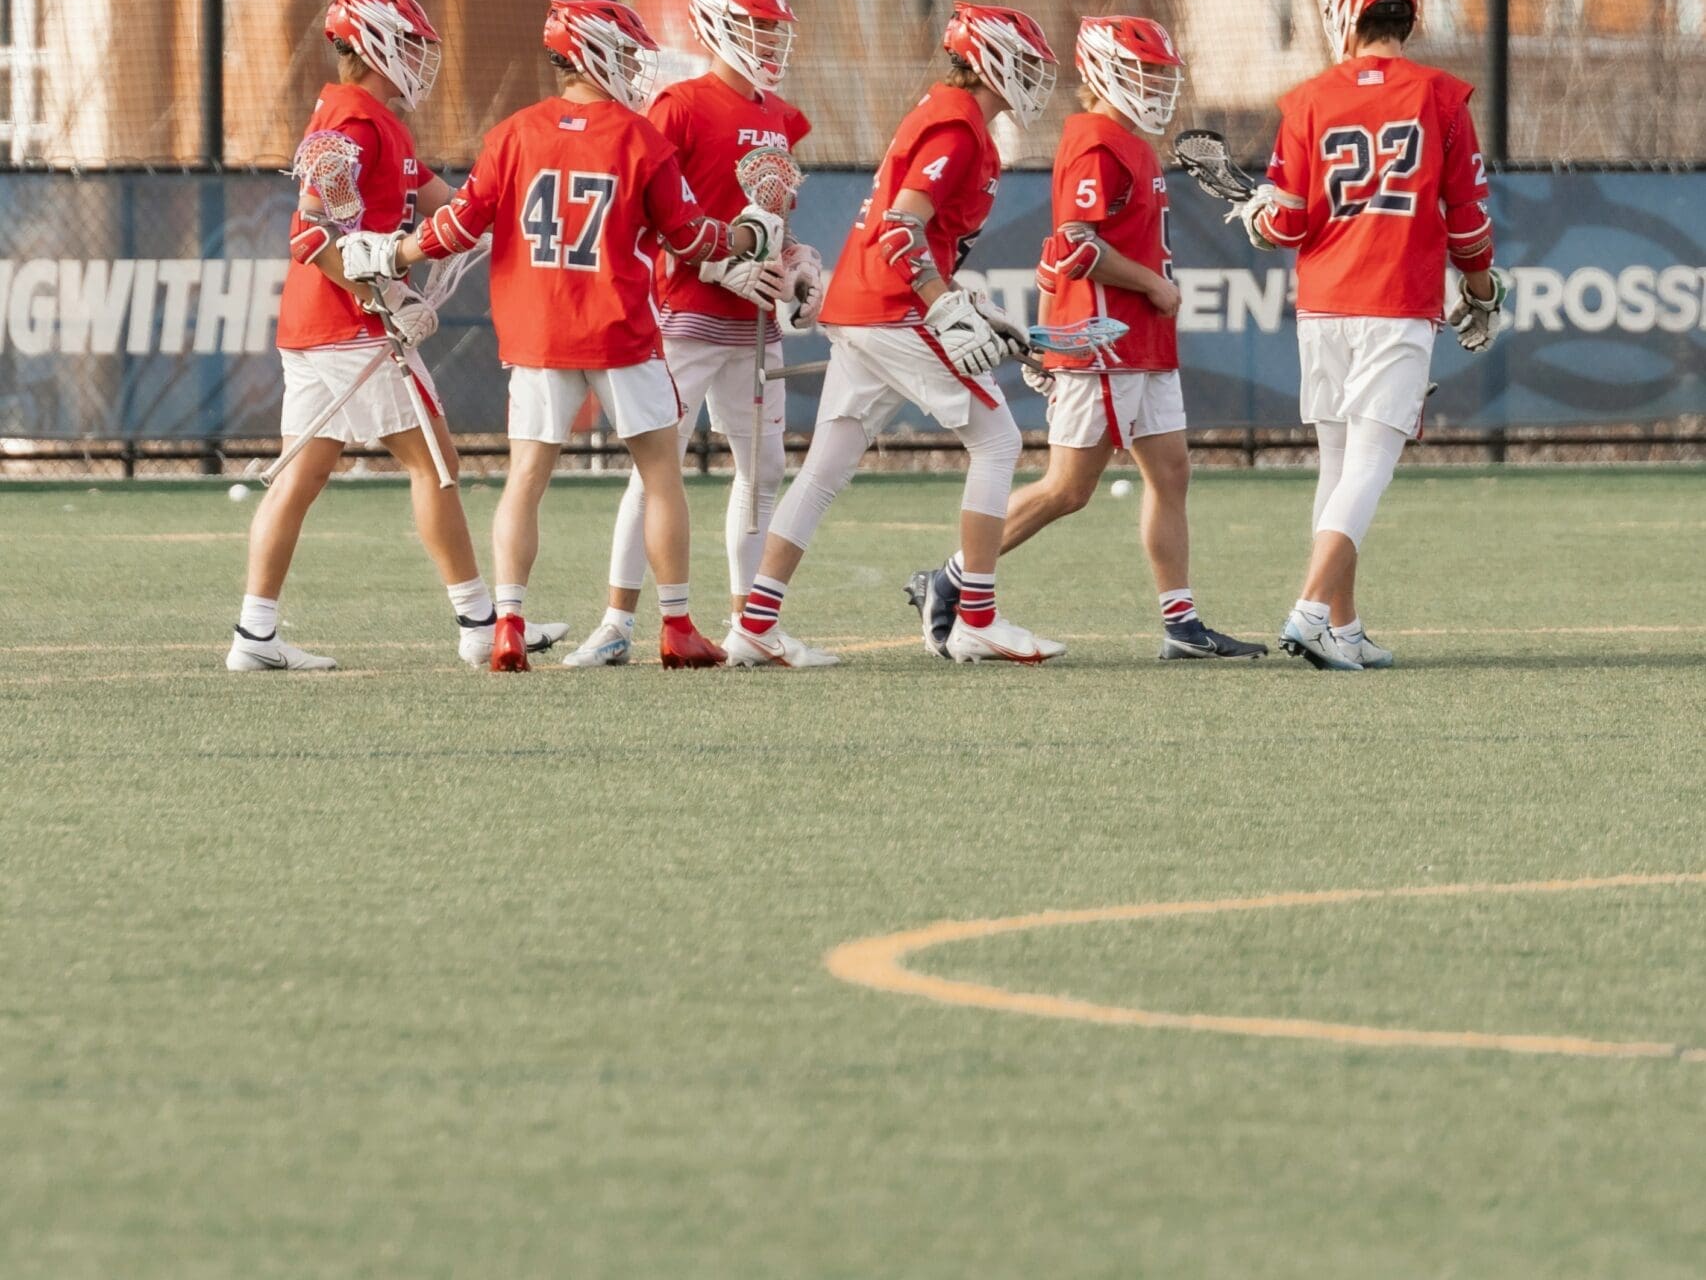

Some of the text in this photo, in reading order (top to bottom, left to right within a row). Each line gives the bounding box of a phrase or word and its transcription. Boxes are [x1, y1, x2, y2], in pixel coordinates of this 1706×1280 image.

[922, 155, 949, 182] 4
[1075, 179, 1097, 209] 5
[1319, 117, 1424, 223] 22
[520, 168, 619, 272] 47
[0, 258, 291, 355] GWITHF
